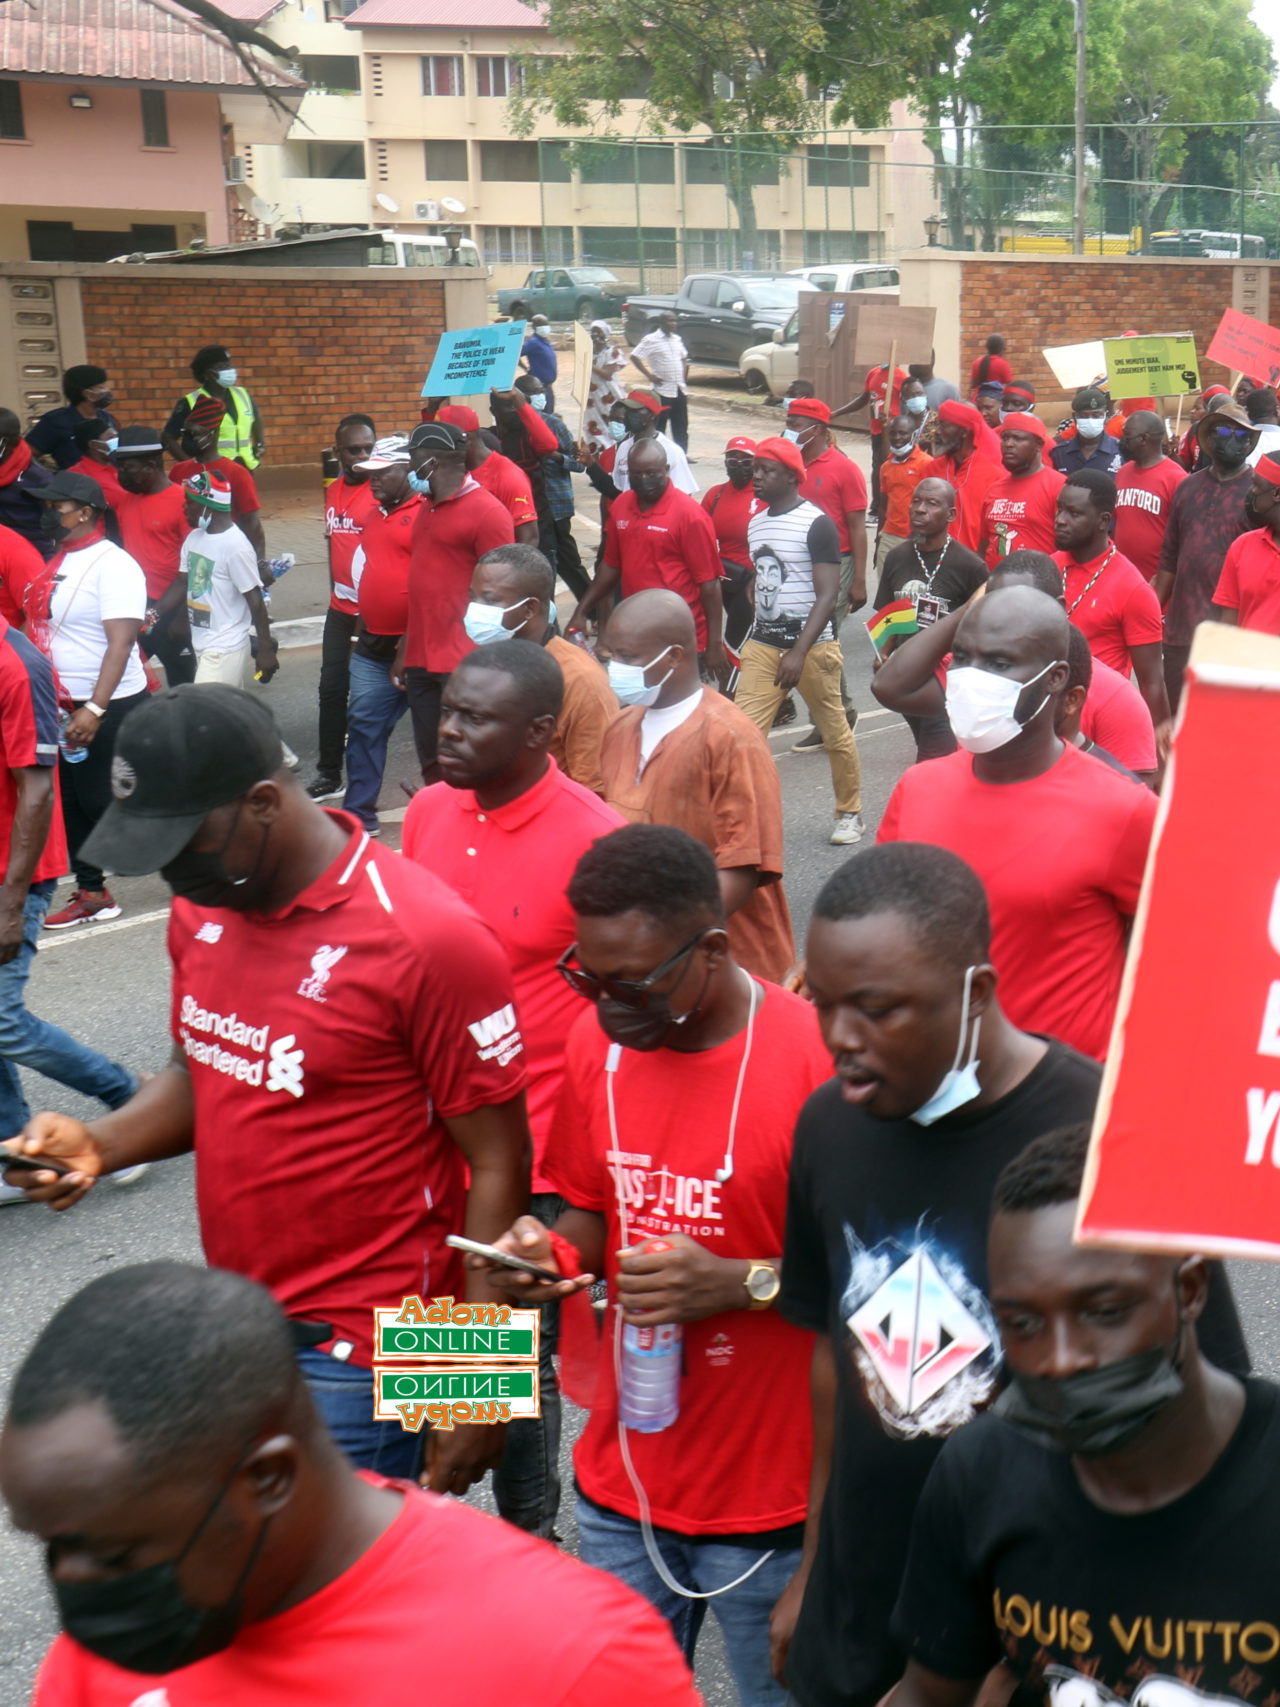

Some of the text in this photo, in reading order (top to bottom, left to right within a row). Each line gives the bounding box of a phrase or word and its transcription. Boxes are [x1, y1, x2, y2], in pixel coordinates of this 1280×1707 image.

[463, 350, 481, 358] POLICE
[489, 346, 505, 356] WEAK
[447, 361, 472, 370] BECAUSE
[482, 358, 496, 366] YOUR
[1116, 366, 1146, 374] JUDGEMENT
[1115, 488, 1161, 515] ANFORD
[180, 995, 270, 1053] Standard
[993, 1587, 1094, 1653] LOUIS
